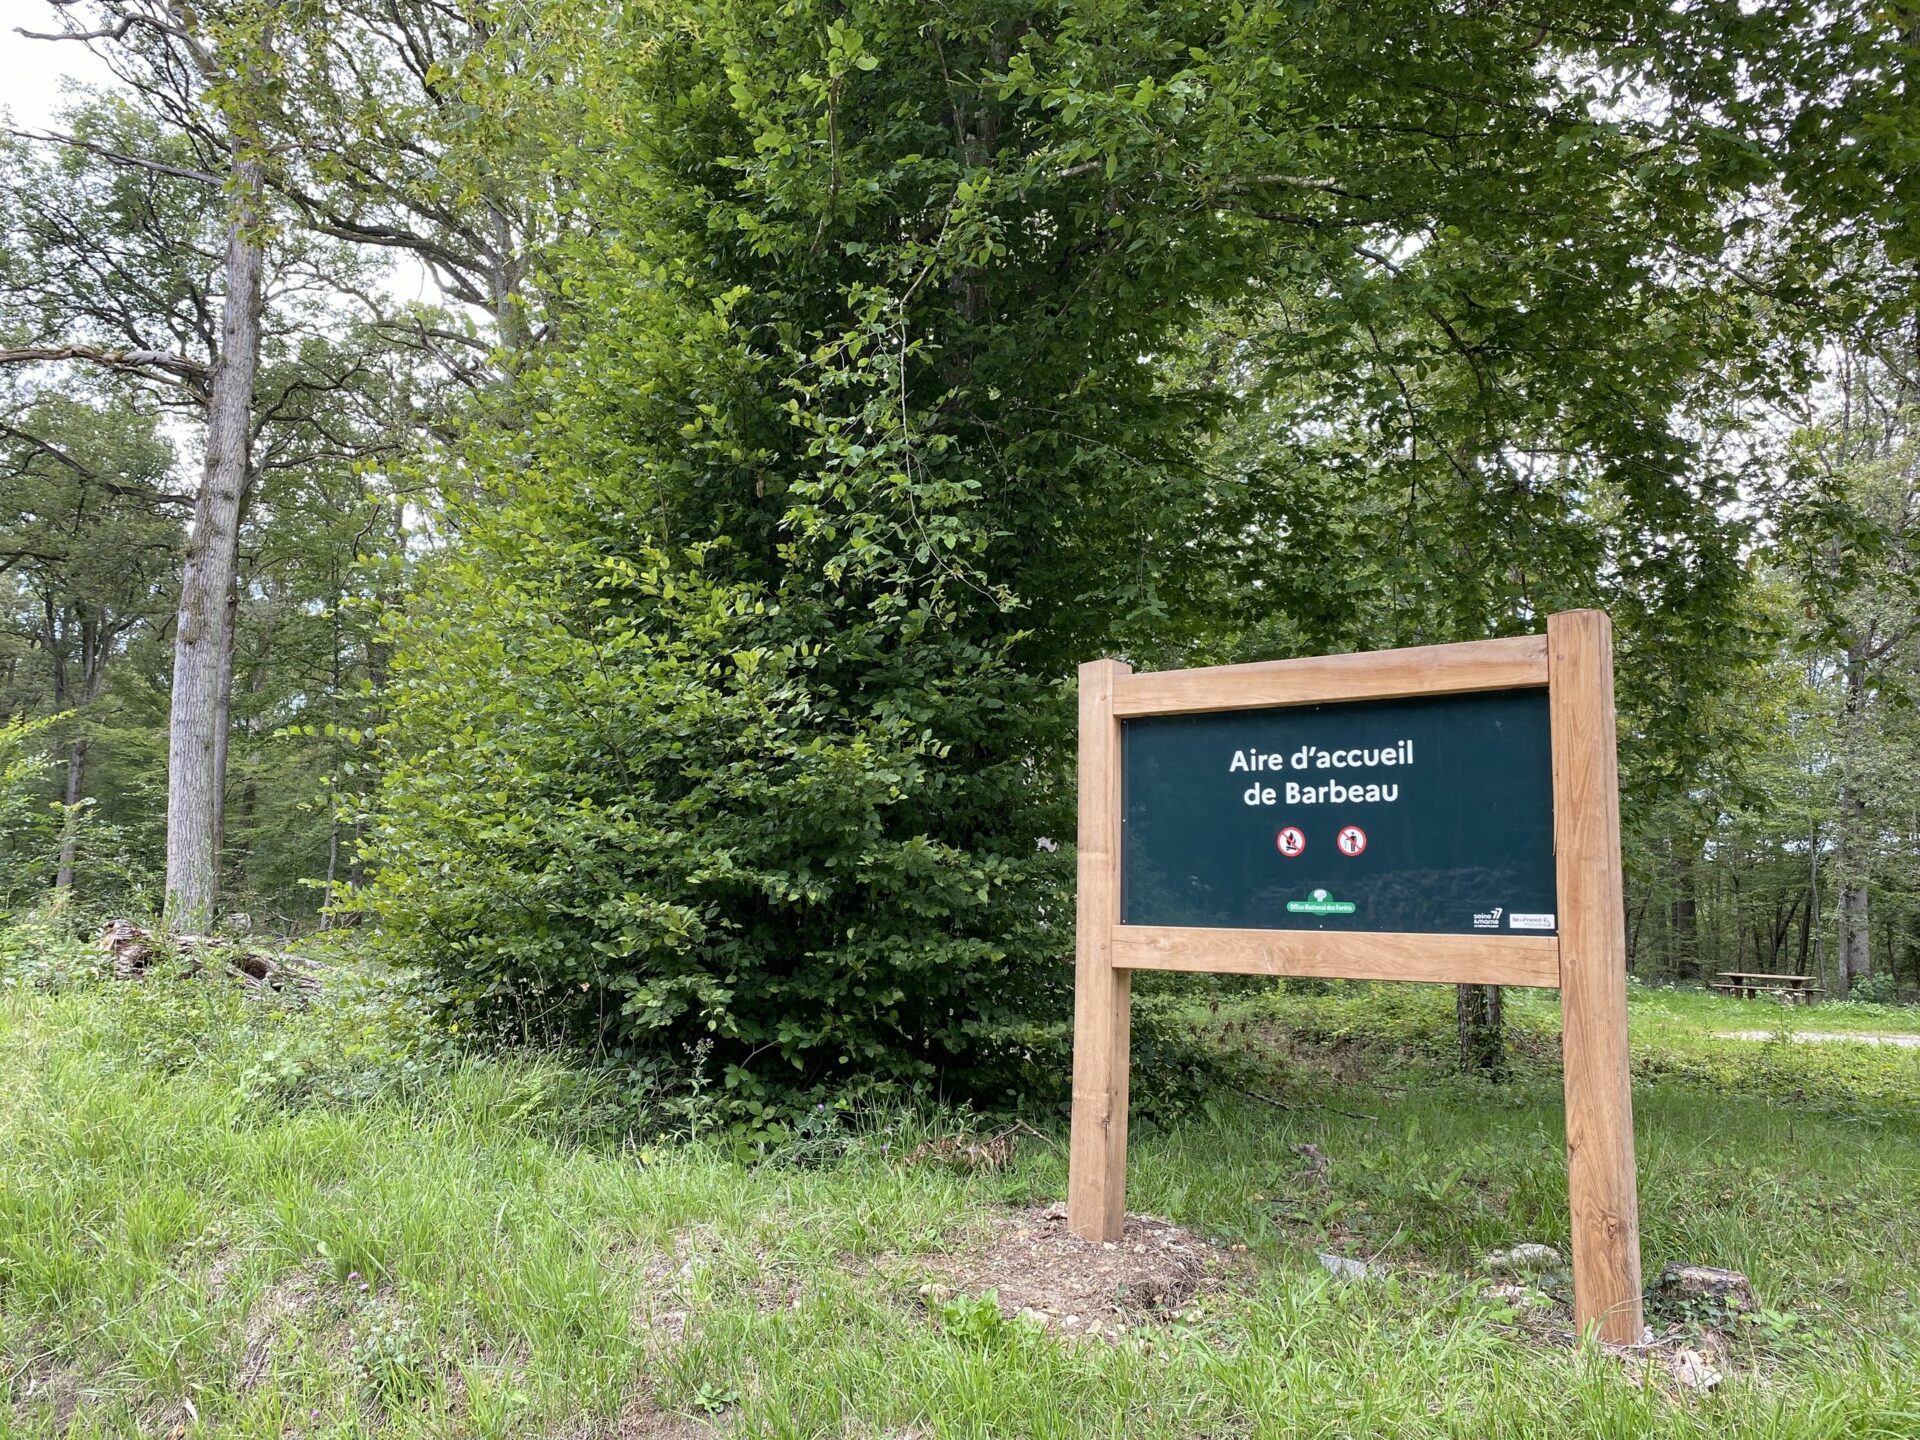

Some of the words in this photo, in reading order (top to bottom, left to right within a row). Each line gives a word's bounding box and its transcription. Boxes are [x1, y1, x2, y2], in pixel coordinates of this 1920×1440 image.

[1229, 748, 1283, 773] Aire
[1243, 782, 1277, 806] de
[1285, 779, 1399, 804] Barbeau
[1490, 907, 1503, 920] 77
